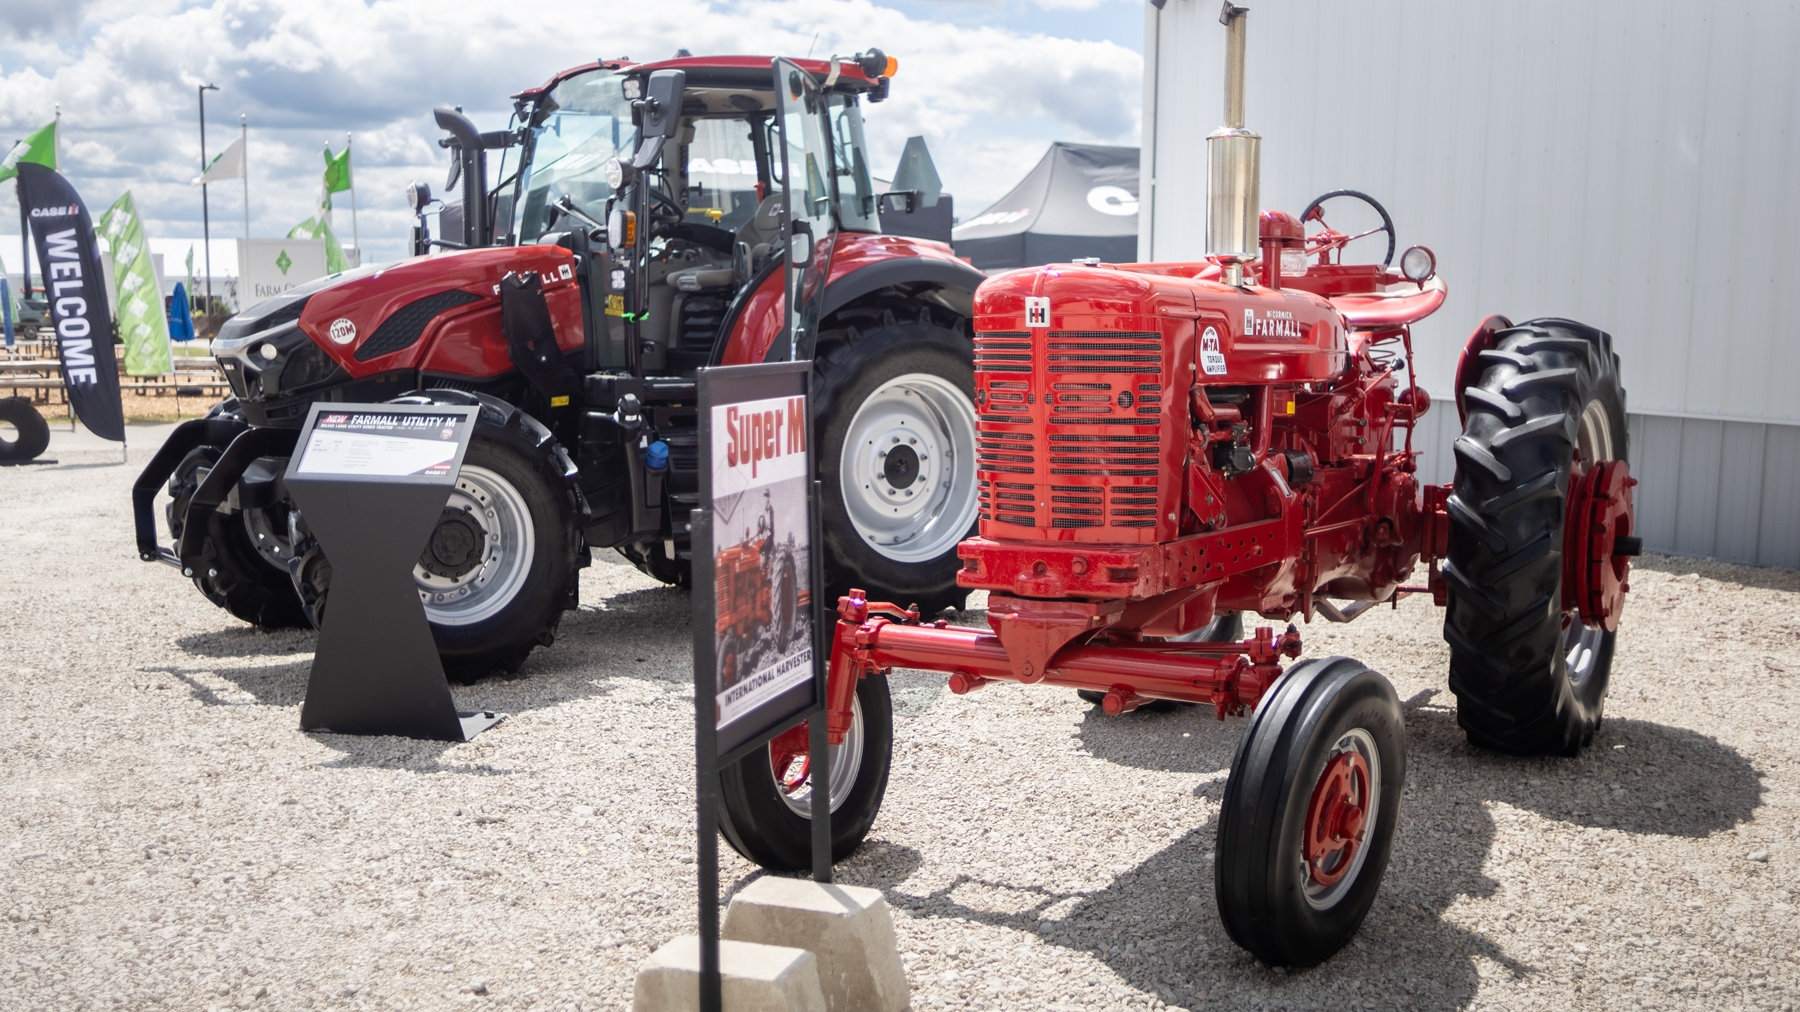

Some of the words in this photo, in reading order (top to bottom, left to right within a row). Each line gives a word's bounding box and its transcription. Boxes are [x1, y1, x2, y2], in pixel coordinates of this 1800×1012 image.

[685, 158, 758, 175] ASE
[31, 206, 67, 218] CASE
[255, 283, 281, 297] FARM
[46, 228, 97, 386] WELCOME
[331, 324, 355, 339] 120M
[1255, 318, 1302, 337] FARMALL
[1207, 355, 1223, 363] TORQUE
[1206, 365, 1226, 373] AMPLIFIER
[326, 415, 347, 423] NEW
[351, 415, 398, 426] FARMALL
[402, 416, 443, 427] UTILITY
[445, 417, 457, 428] M
[727, 406, 784, 479] Super
[787, 397, 806, 455] M
[724, 668, 775, 708] INTERNATIONAL
[776, 649, 812, 677] HARVESTER
